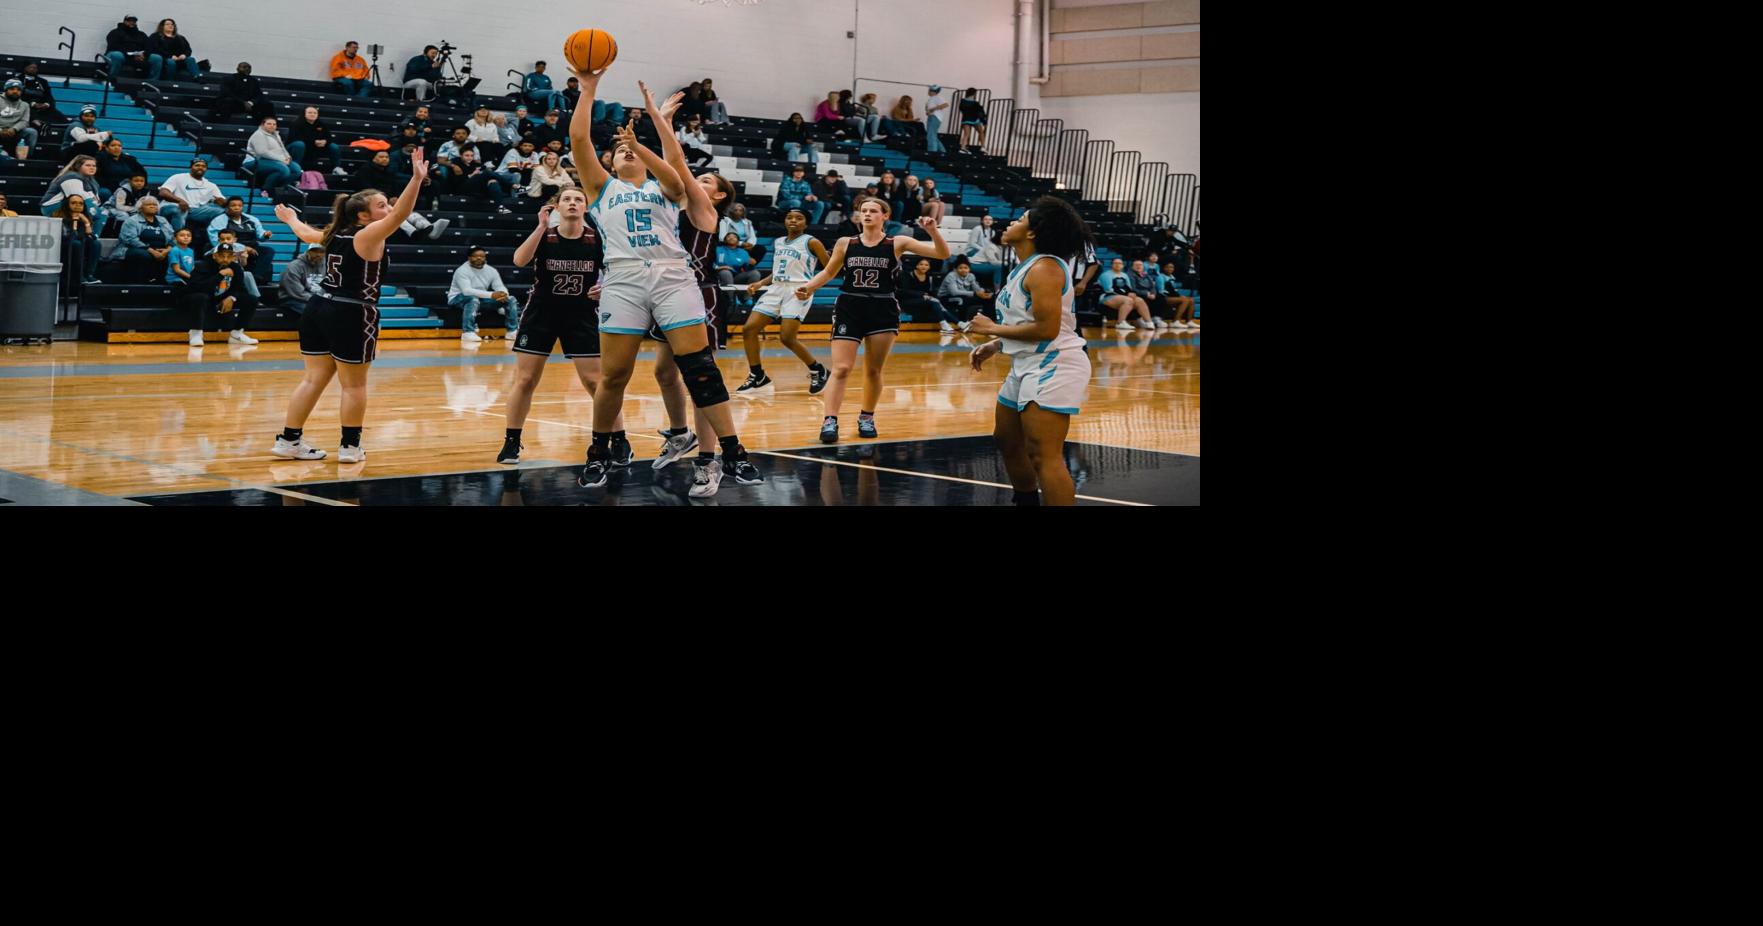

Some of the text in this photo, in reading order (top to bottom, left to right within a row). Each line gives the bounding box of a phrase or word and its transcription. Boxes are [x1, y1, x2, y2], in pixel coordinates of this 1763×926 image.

[608, 191, 666, 209] EASTERN
[625, 209, 652, 232] 15
[627, 234, 661, 248] VIEW
[552, 274, 583, 296] 23
[853, 269, 880, 288] 12
